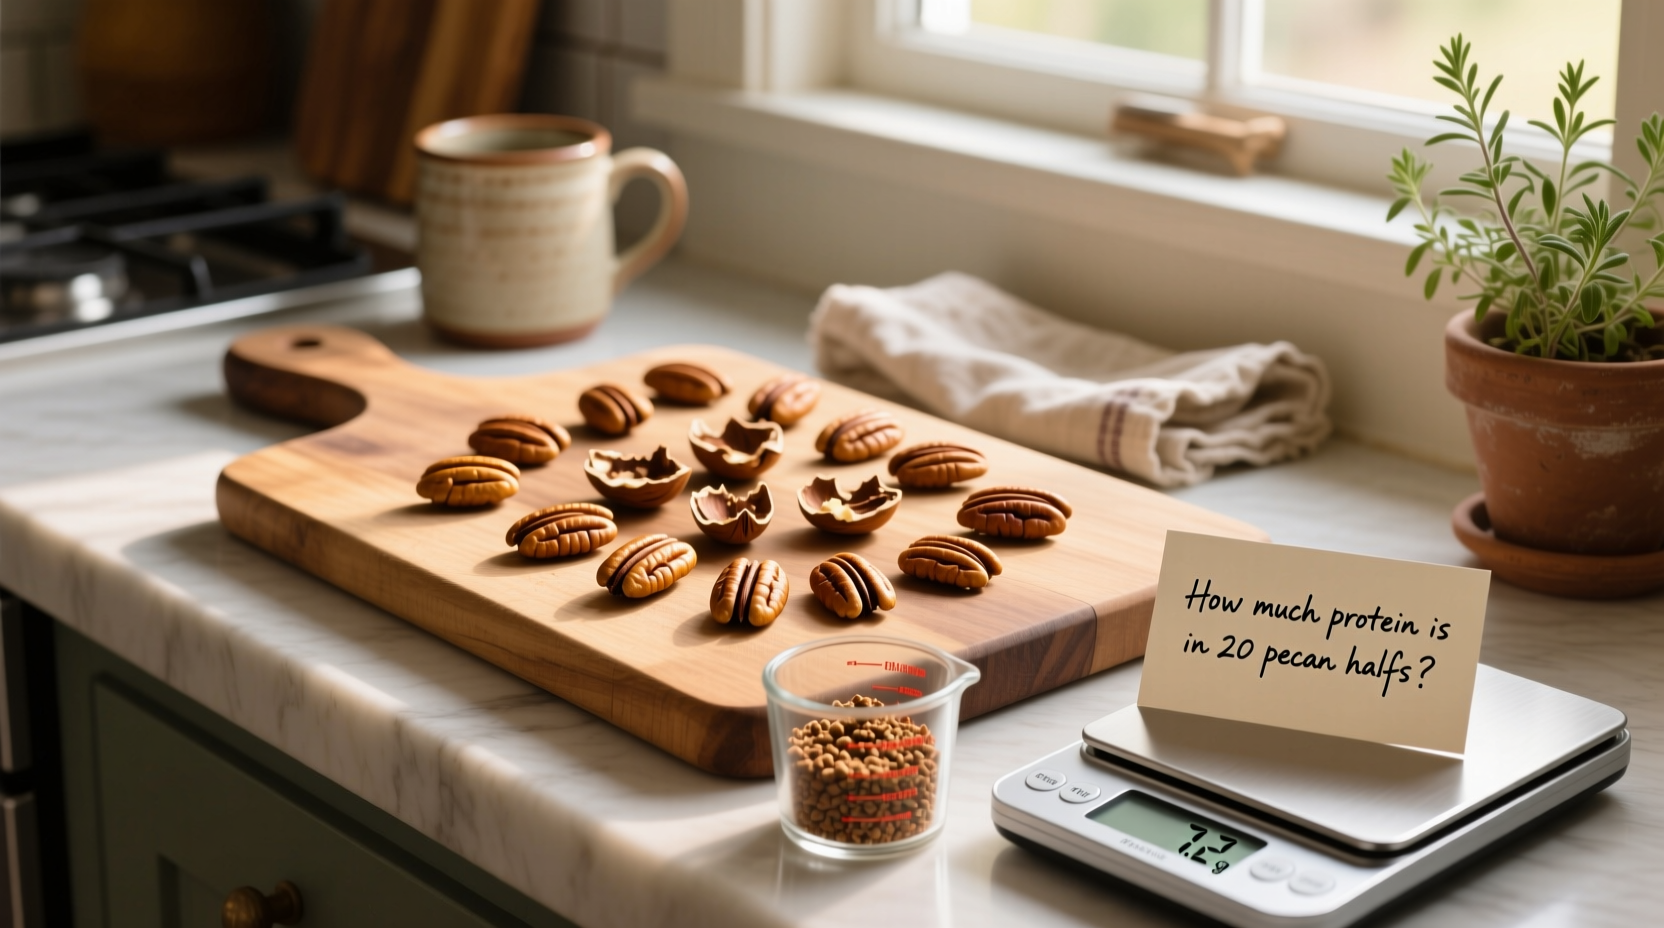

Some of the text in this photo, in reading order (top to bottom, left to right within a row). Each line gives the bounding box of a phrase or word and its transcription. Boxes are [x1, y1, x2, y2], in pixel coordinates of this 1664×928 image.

[1184, 578, 1452, 641] How much protein is
[1183, 632, 1437, 698] in 20 pecan halfs?
